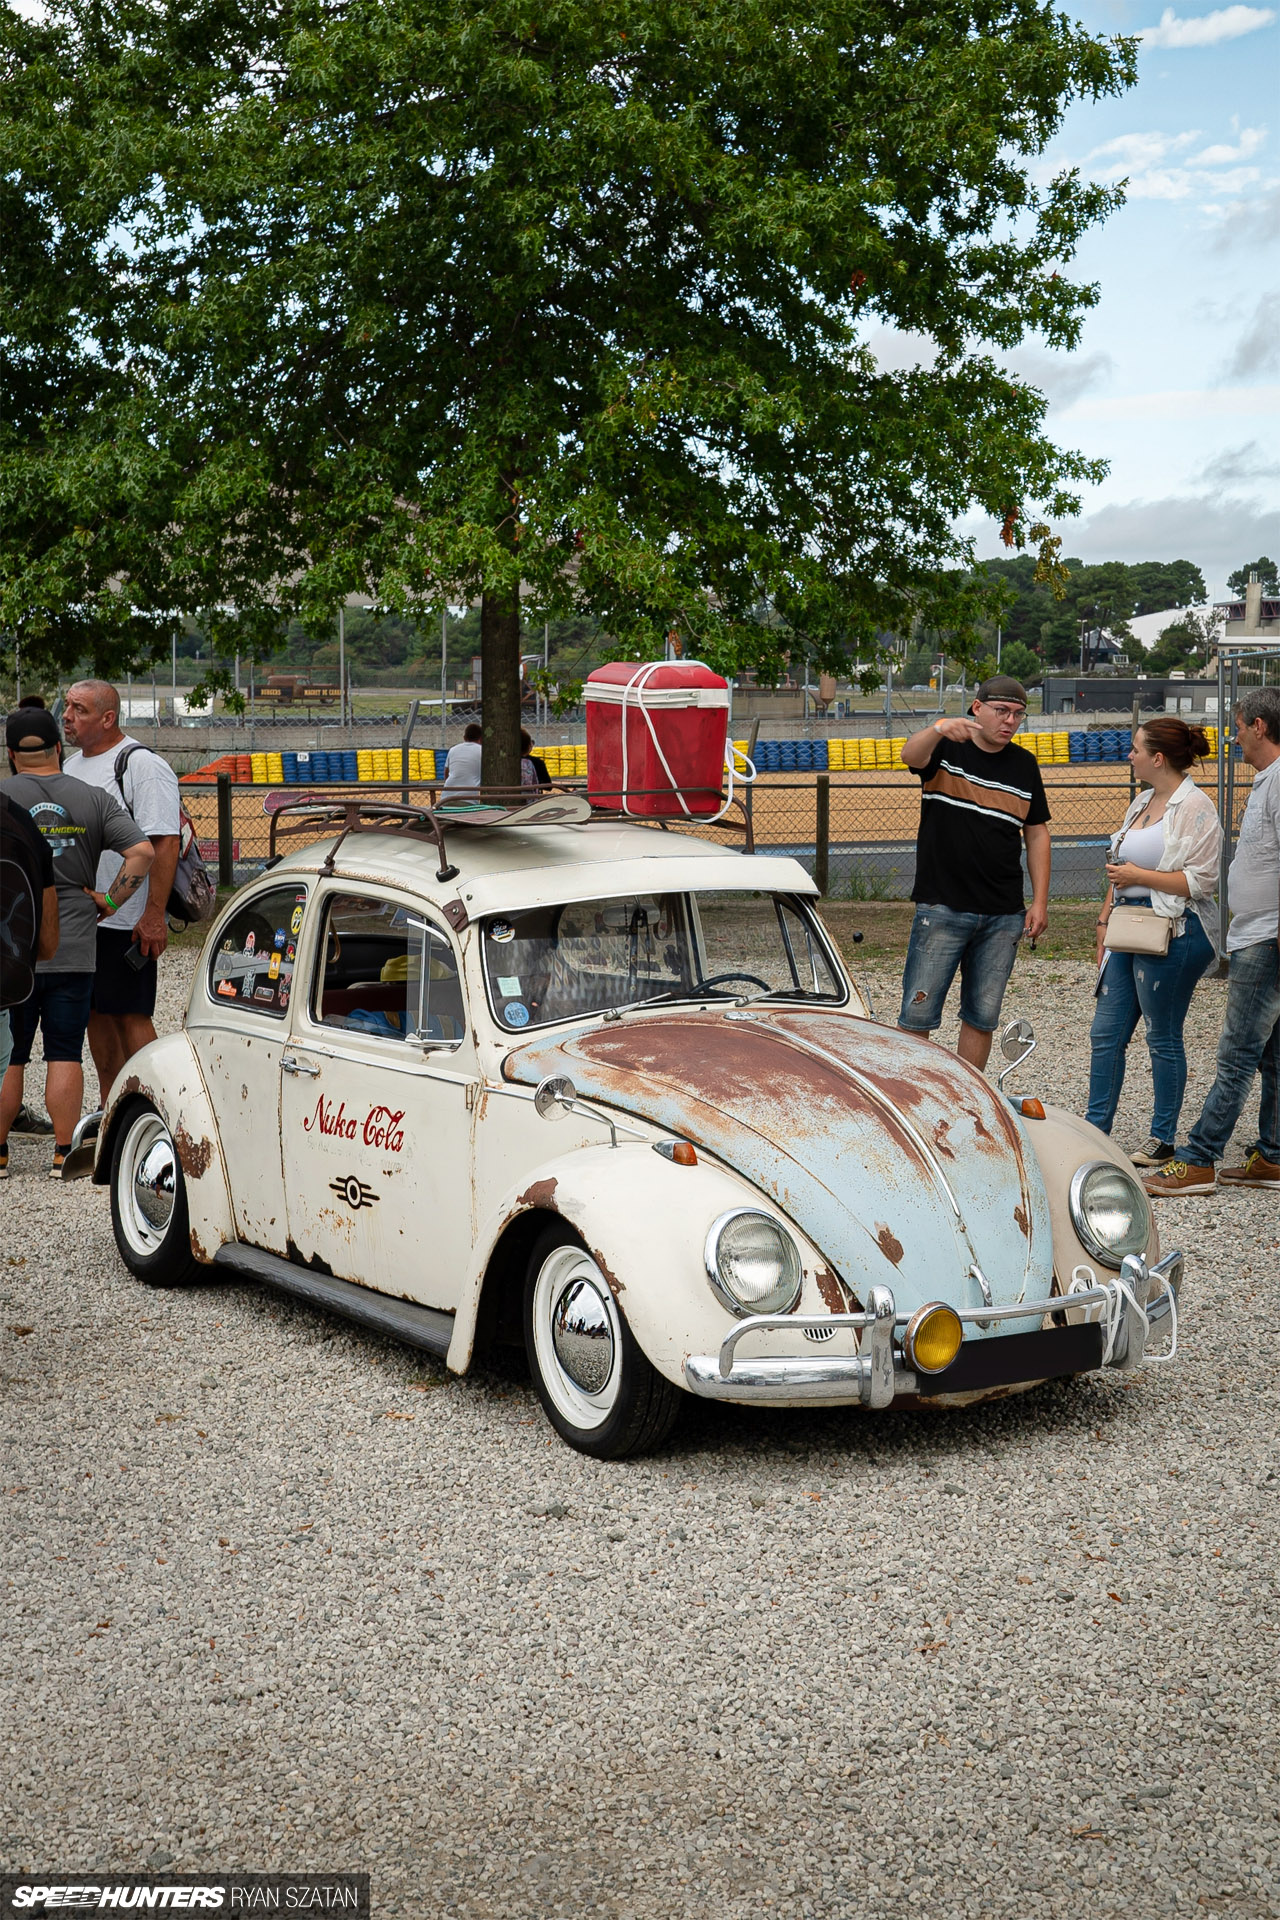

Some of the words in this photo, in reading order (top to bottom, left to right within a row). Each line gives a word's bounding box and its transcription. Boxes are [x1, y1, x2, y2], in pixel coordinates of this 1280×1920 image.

[49, 826, 87, 834] ANGEVIN
[303, 1092, 358, 1140] Nuka
[362, 1105, 406, 1153] Cola
